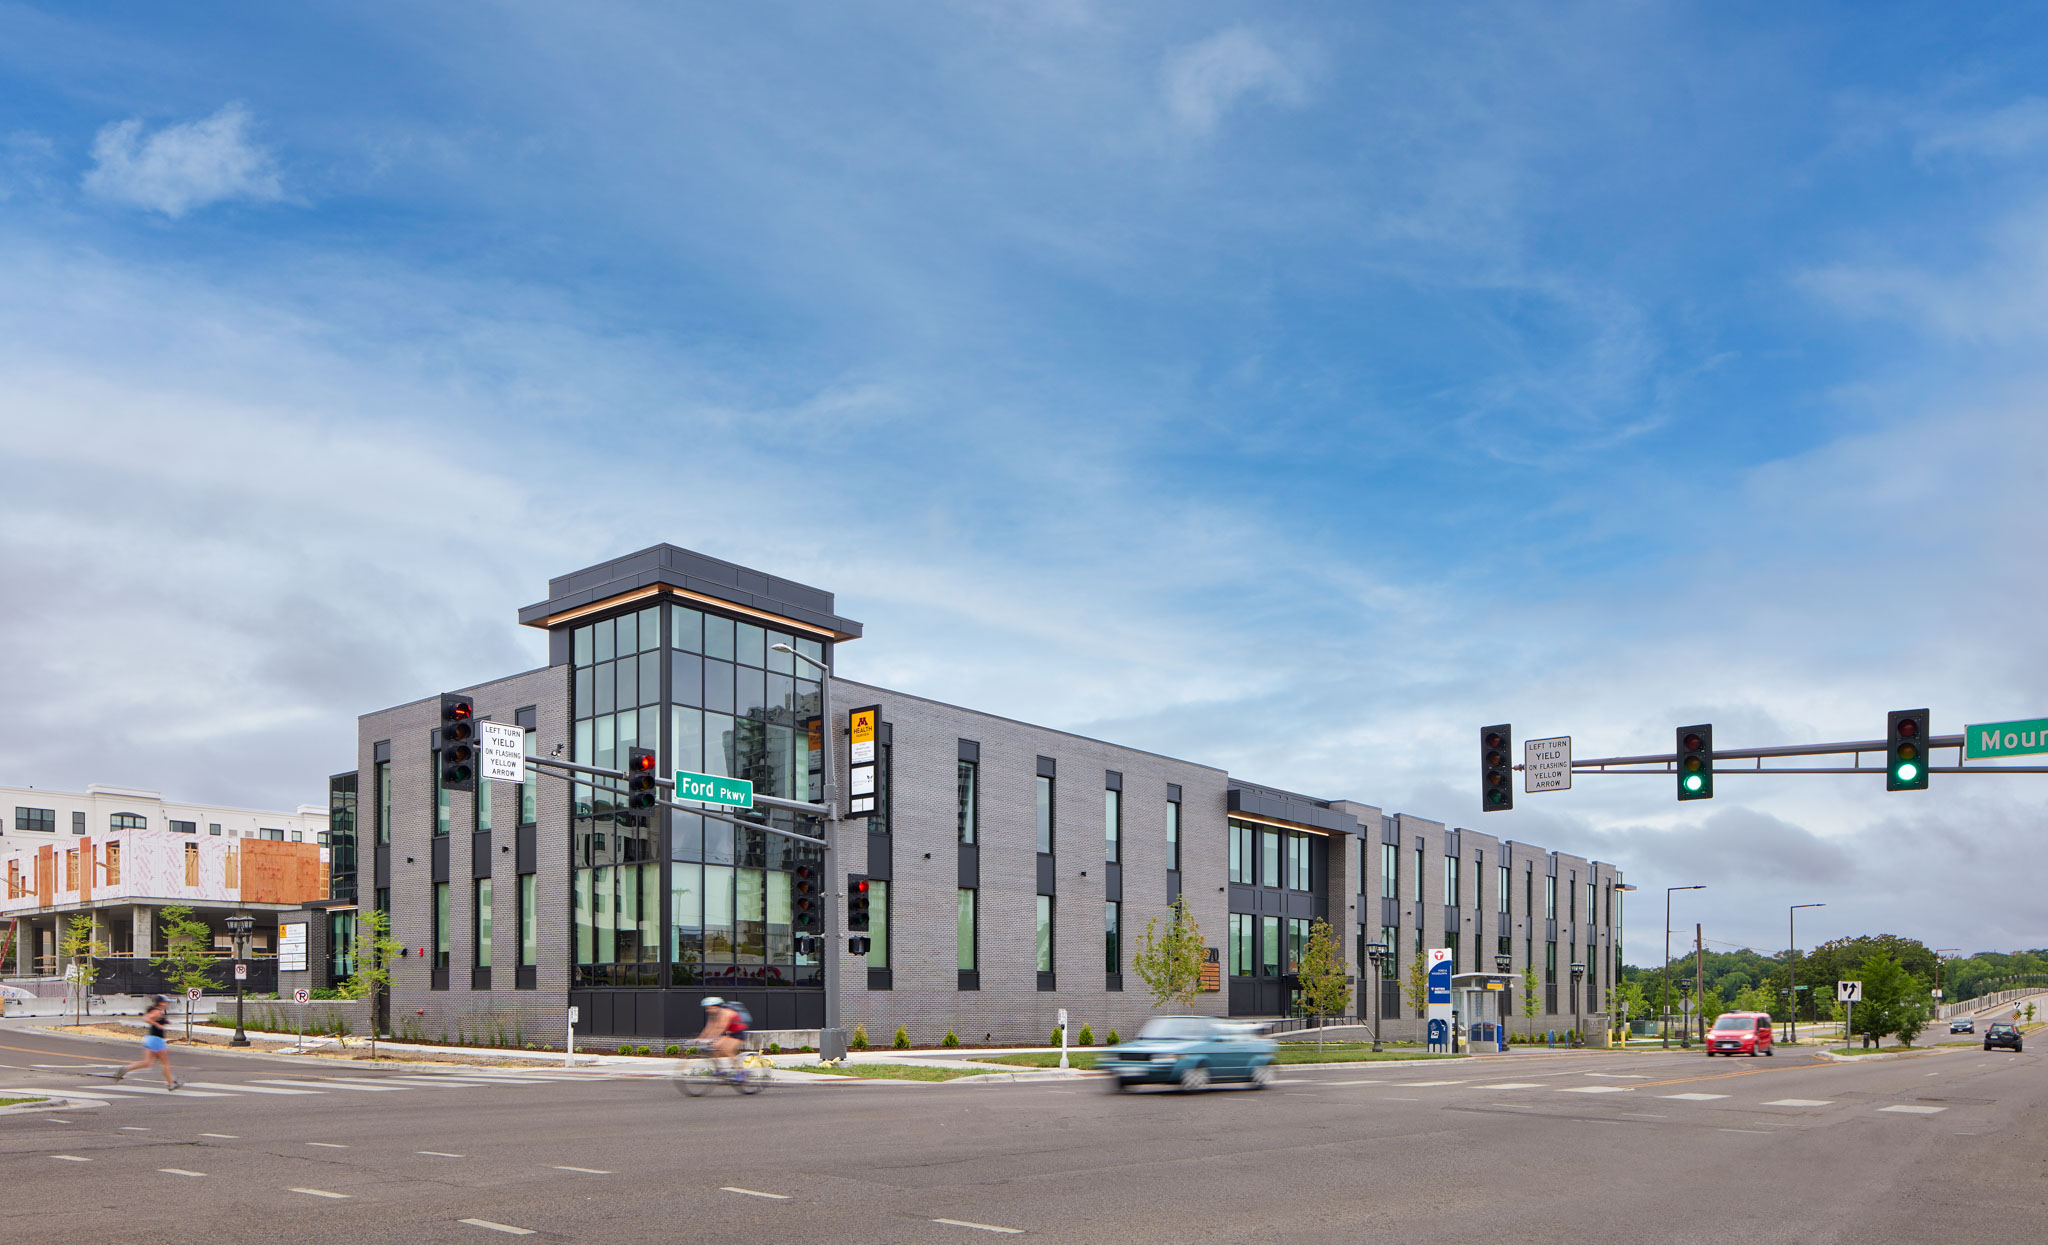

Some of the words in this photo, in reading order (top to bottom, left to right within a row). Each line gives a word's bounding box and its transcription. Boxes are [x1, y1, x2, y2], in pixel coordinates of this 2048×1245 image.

[485, 726, 500, 734] LEFT
[504, 729, 521, 738] TURN
[853, 726, 873, 735] HEALTH
[491, 737, 515, 748] YIELD
[1529, 743, 1545, 751] LEFT
[1549, 740, 1567, 749] TURN
[495, 749, 521, 760] FLASHING
[1535, 751, 1561, 761] YIELD
[490, 758, 517, 768] YELLOW
[1540, 760, 1568, 770] FLASHING
[491, 768, 515, 777] ARROW
[1534, 771, 1562, 779] YELLOW
[1536, 780, 1561, 788] ARROW
[682, 777, 714, 798] Ford
[720, 787, 746, 804] Pkwy
